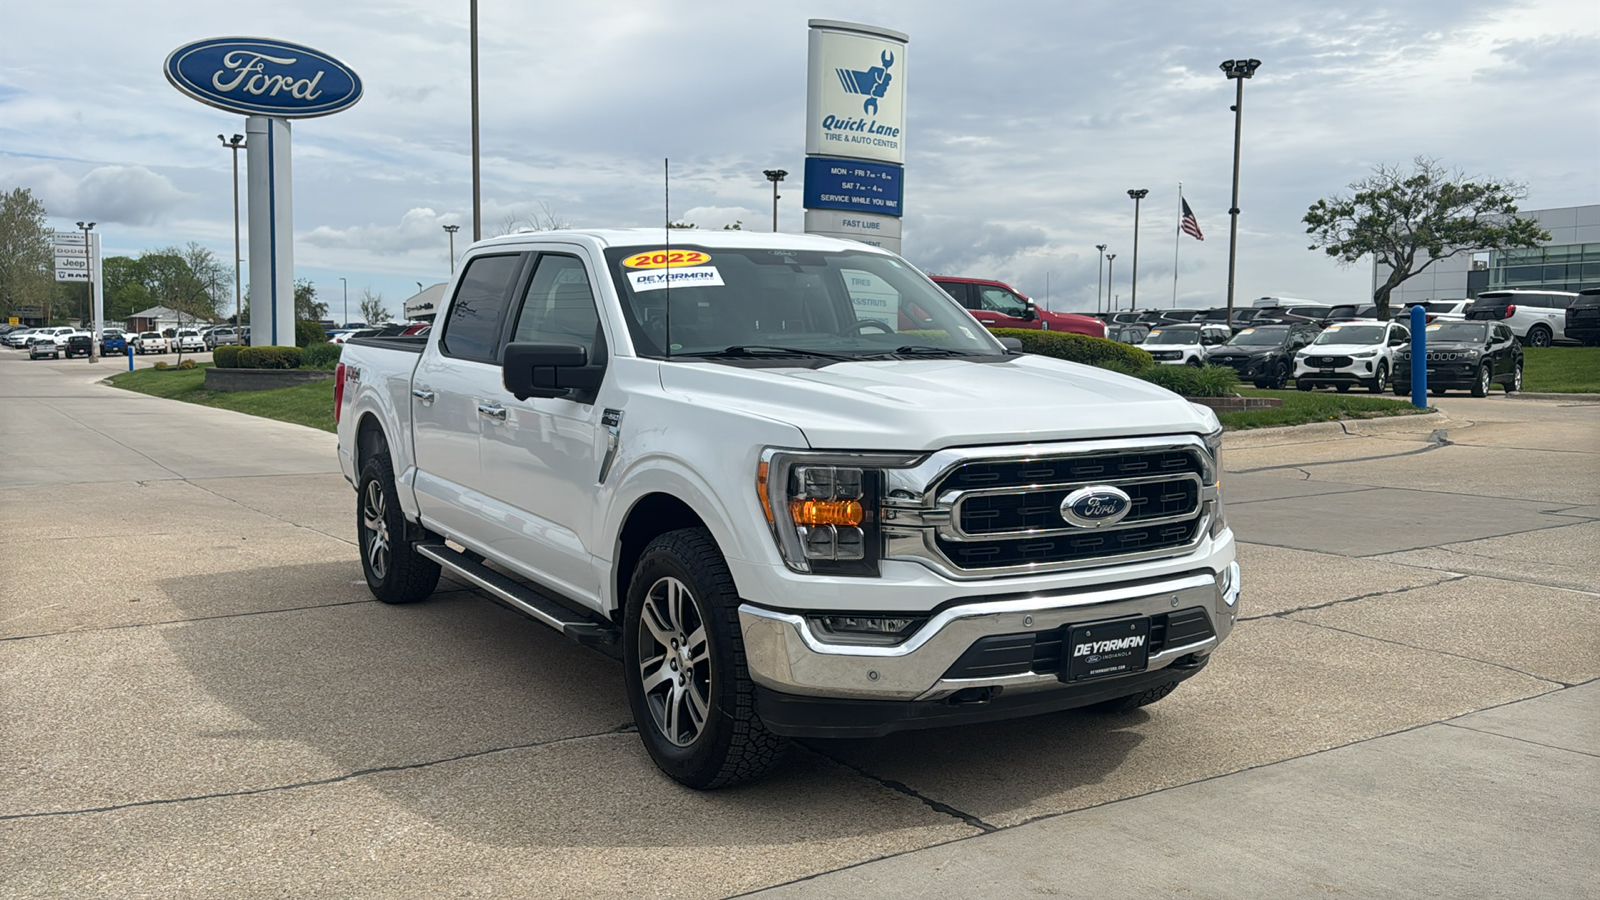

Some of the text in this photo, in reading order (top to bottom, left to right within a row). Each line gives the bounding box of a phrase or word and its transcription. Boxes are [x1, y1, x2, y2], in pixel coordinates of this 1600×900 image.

[212, 50, 325, 101] Ford
[822, 114, 900, 137] Quick Lane
[824, 133, 898, 149] TIRE & AUTO CENTER
[830, 167, 847, 175] MON
[854, 169, 865, 177] FRI
[841, 182, 854, 190] SAT
[820, 194, 850, 203] SERVICE
[851, 196, 871, 205] WHILE
[872, 198, 884, 206] YOU
[842, 219, 881, 229] FAST LUBE
[62, 259, 86, 268] Jeep
[634, 252, 703, 266] 2022
[637, 272, 714, 283] DEYARMAN
[851, 278, 871, 287] TIRES
[852, 298, 887, 307] KS/STRUTS
[1084, 496, 1117, 516] Ford
[1073, 635, 1146, 657] DEYARMAN
[1102, 651, 1132, 660] INDIANOLA
